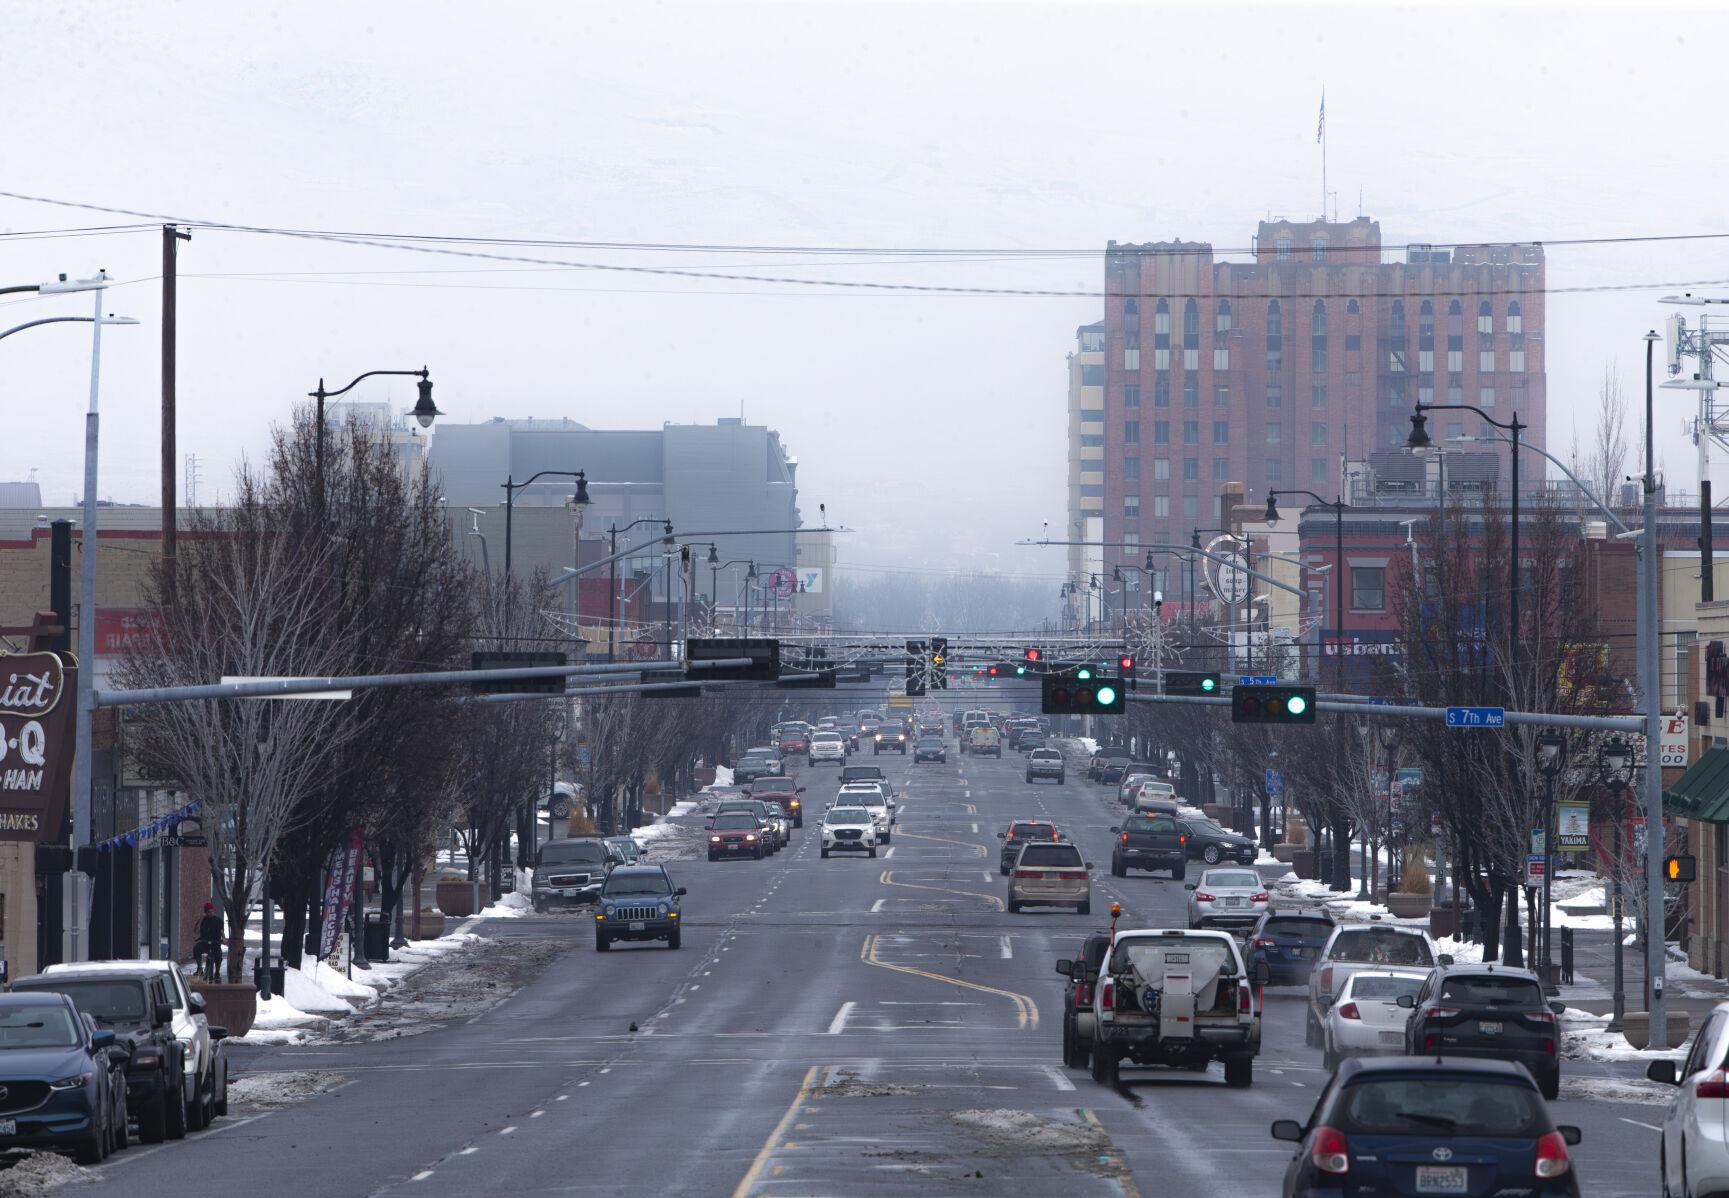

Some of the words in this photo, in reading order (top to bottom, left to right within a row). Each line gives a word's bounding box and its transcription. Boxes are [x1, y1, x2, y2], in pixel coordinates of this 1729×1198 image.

[1449, 712, 1456, 724] S
[1485, 712, 1502, 724] Ave
[1560, 836, 1587, 845] YAKIMA
